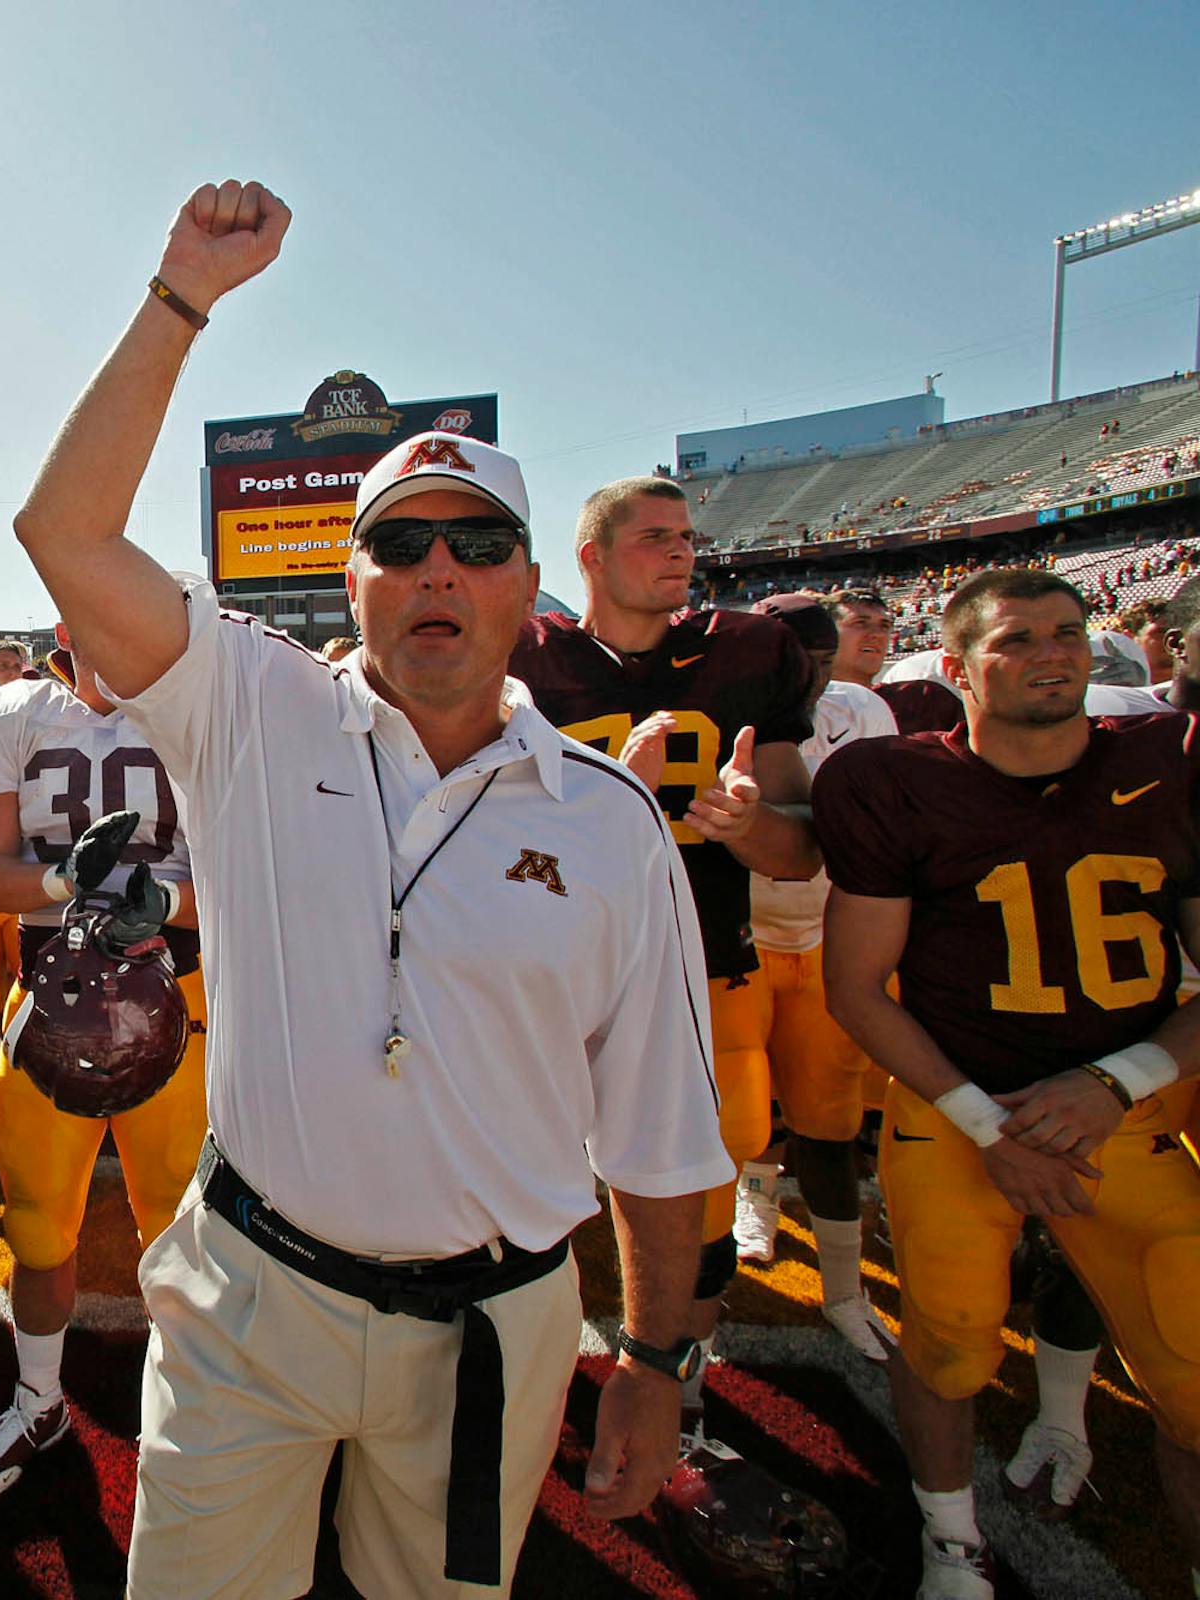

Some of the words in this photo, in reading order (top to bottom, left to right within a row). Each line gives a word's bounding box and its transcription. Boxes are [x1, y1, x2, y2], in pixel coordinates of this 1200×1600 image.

[328, 388, 362, 404] TCF
[322, 401, 368, 419] BANK
[310, 420, 381, 436] STADIUM
[440, 415, 466, 429] DQ
[239, 474, 297, 493] Post
[304, 471, 364, 487] Gam
[236, 522, 269, 533] One
[274, 519, 312, 530] hour
[240, 543, 273, 554] Line
[278, 539, 332, 552] begins
[856, 538, 872, 550] 54
[719, 554, 731, 566] 10
[787, 547, 800, 559] 15
[23, 747, 178, 864] 30
[506, 848, 569, 897] M
[976, 853, 1168, 1014] 16
